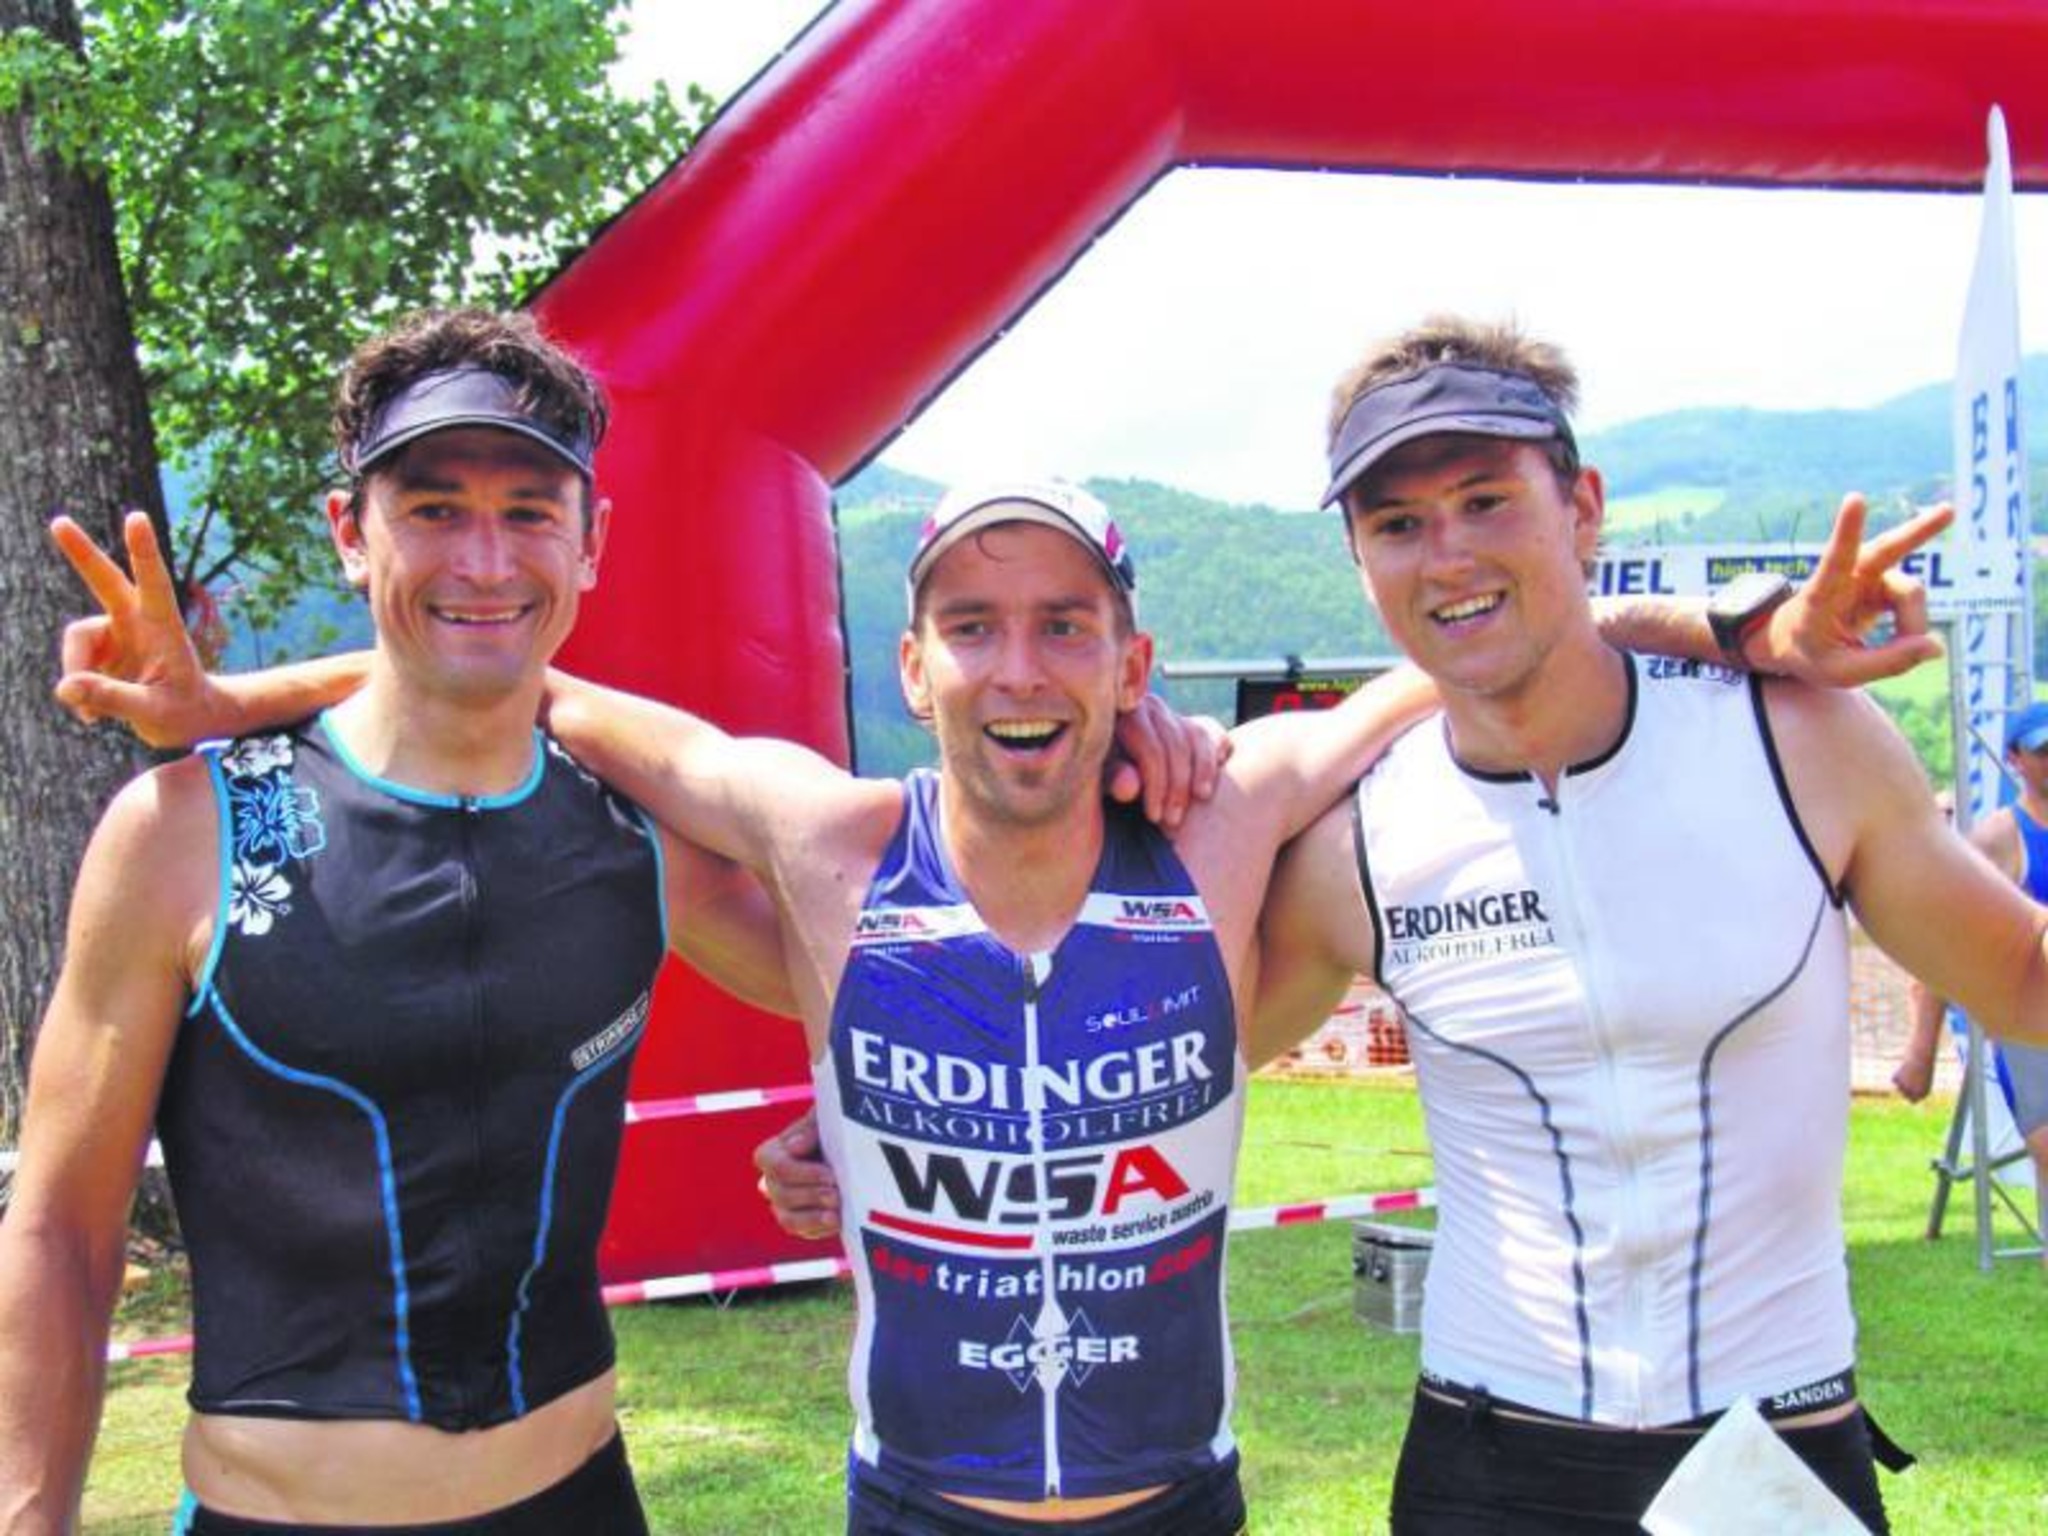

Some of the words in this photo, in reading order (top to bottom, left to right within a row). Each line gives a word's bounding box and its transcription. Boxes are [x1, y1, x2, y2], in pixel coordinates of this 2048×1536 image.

[1588, 559, 1675, 596] IEL
[1901, 552, 1954, 588] EL
[1122, 900, 1196, 919] WSA
[1384, 889, 1549, 940] ERDINGER
[849, 1027, 1213, 1112] ERDINGER
[859, 1083, 1212, 1145] ALKOHOLFREI
[879, 1141, 1190, 1223] WSA
[1053, 1223, 1107, 1246] waste
[958, 1334, 1140, 1370] EGGER
[1772, 1379, 1846, 1410] SANDEN
